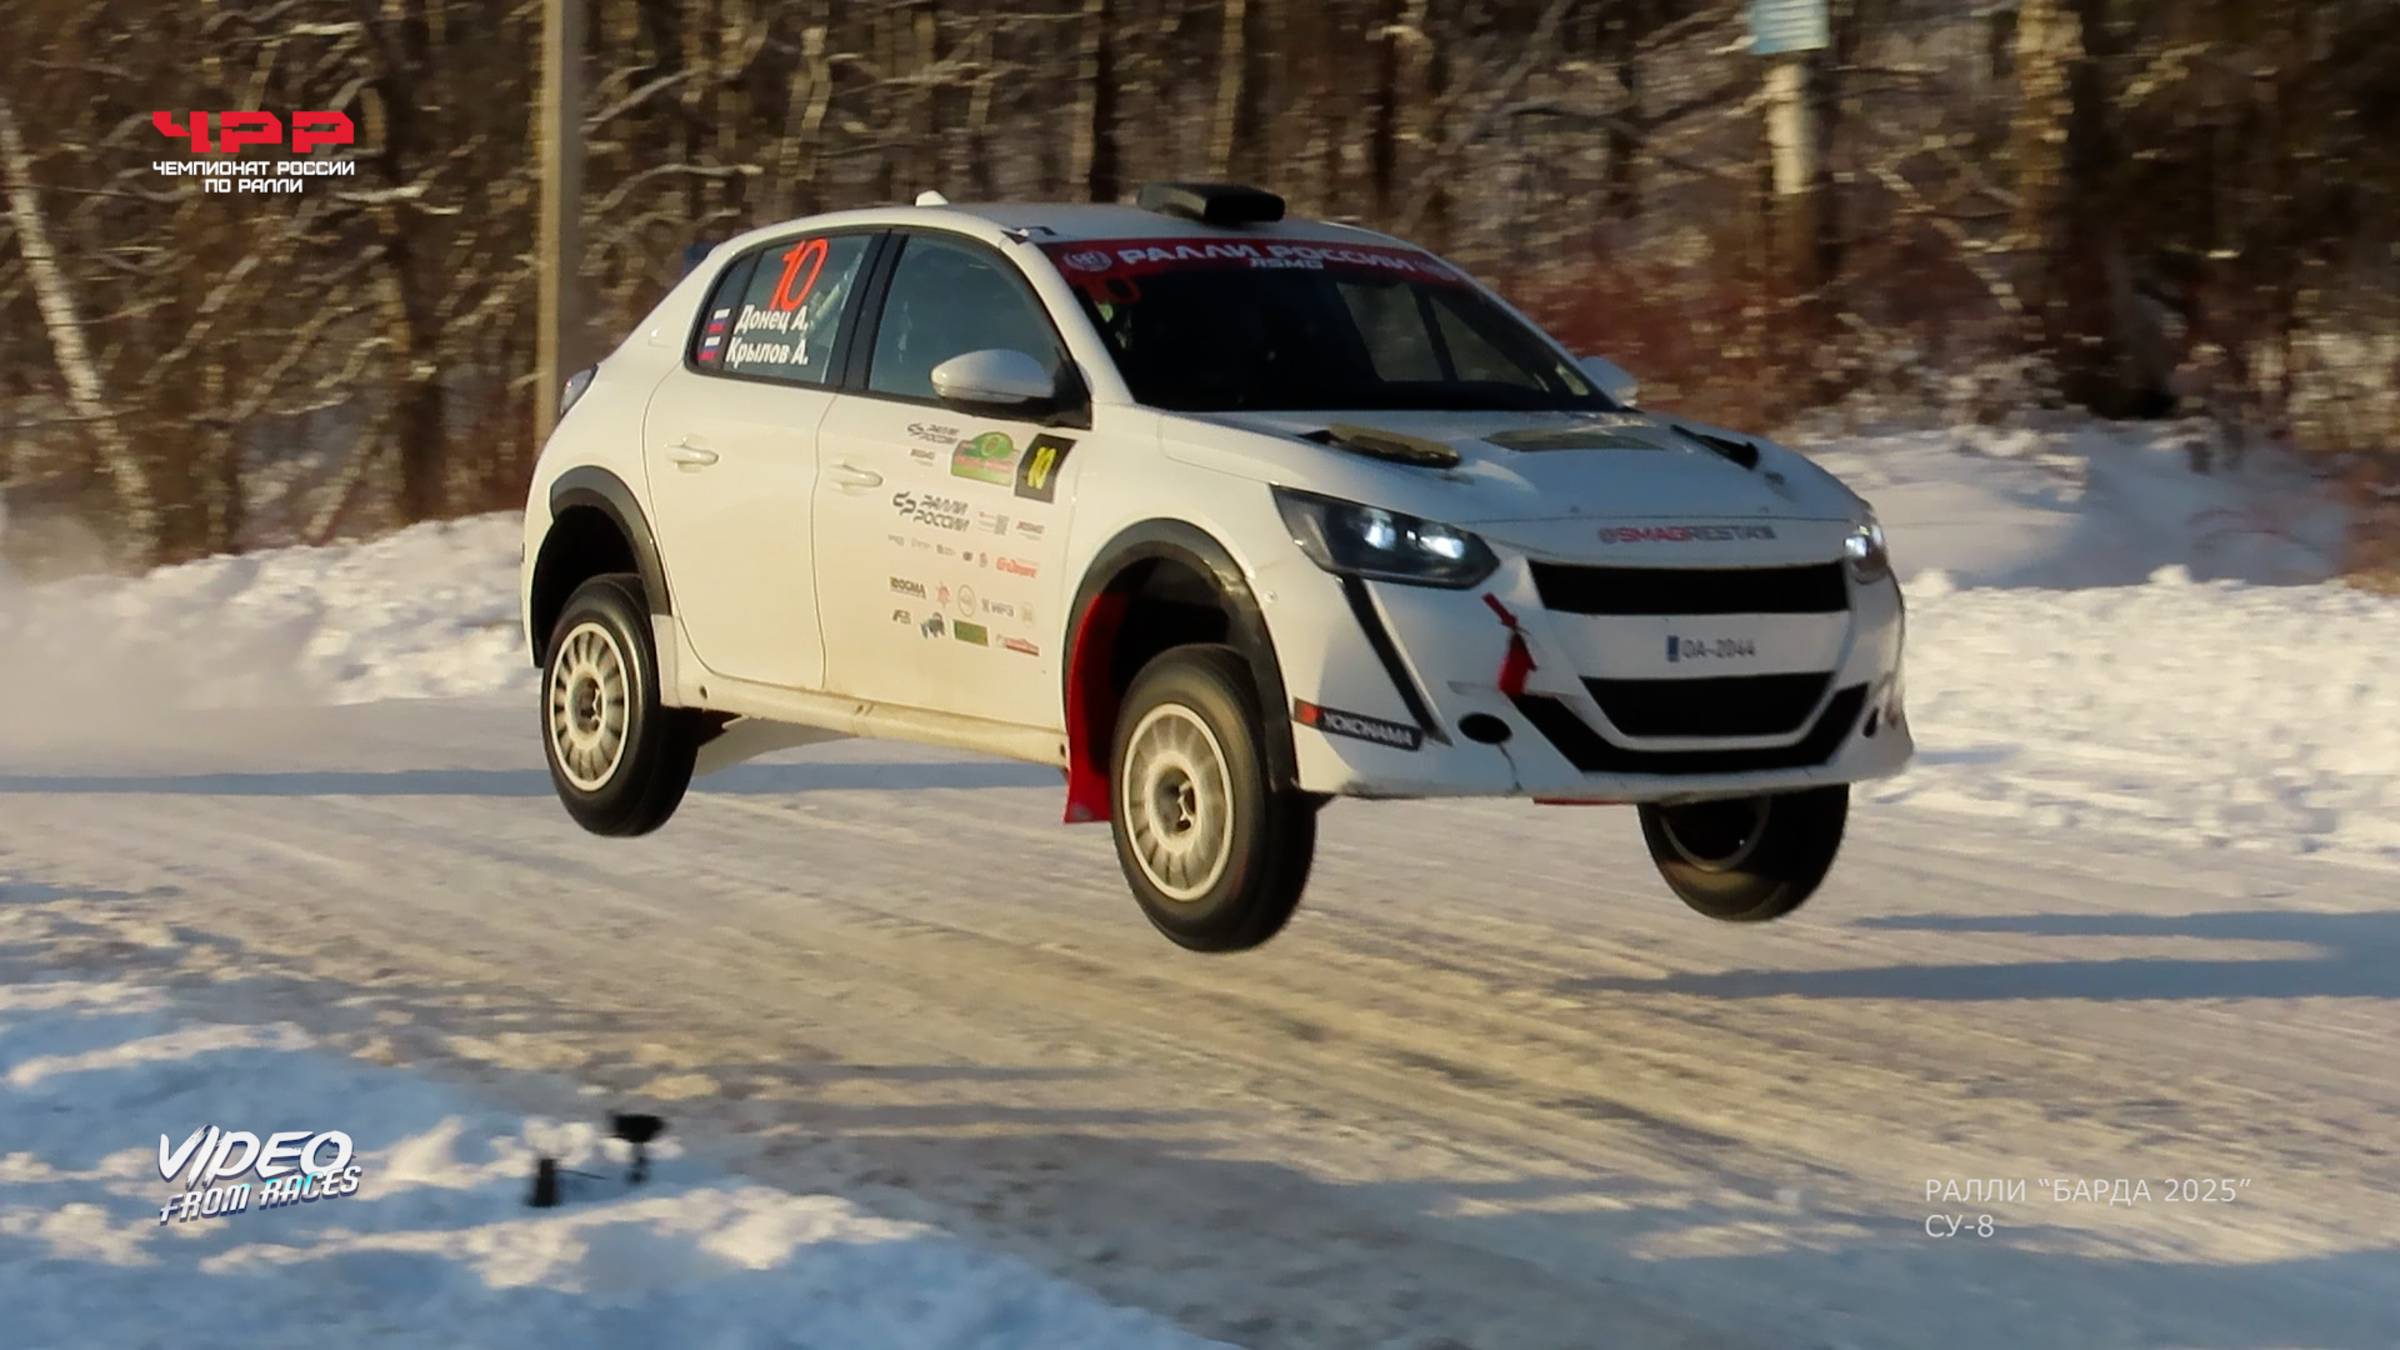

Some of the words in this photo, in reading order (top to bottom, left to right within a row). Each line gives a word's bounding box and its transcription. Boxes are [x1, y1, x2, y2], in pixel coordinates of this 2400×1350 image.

[1117, 244, 1259, 265] РАЛЛИ
[1266, 244, 1416, 272] РОССИИ
[769, 237, 829, 312] 10
[733, 304, 791, 334] Донец
[790, 305, 809, 331] А.
[725, 337, 791, 369] Крылов
[791, 339, 808, 365] А.
[1323, 710, 1414, 747] YOKOHAMA
